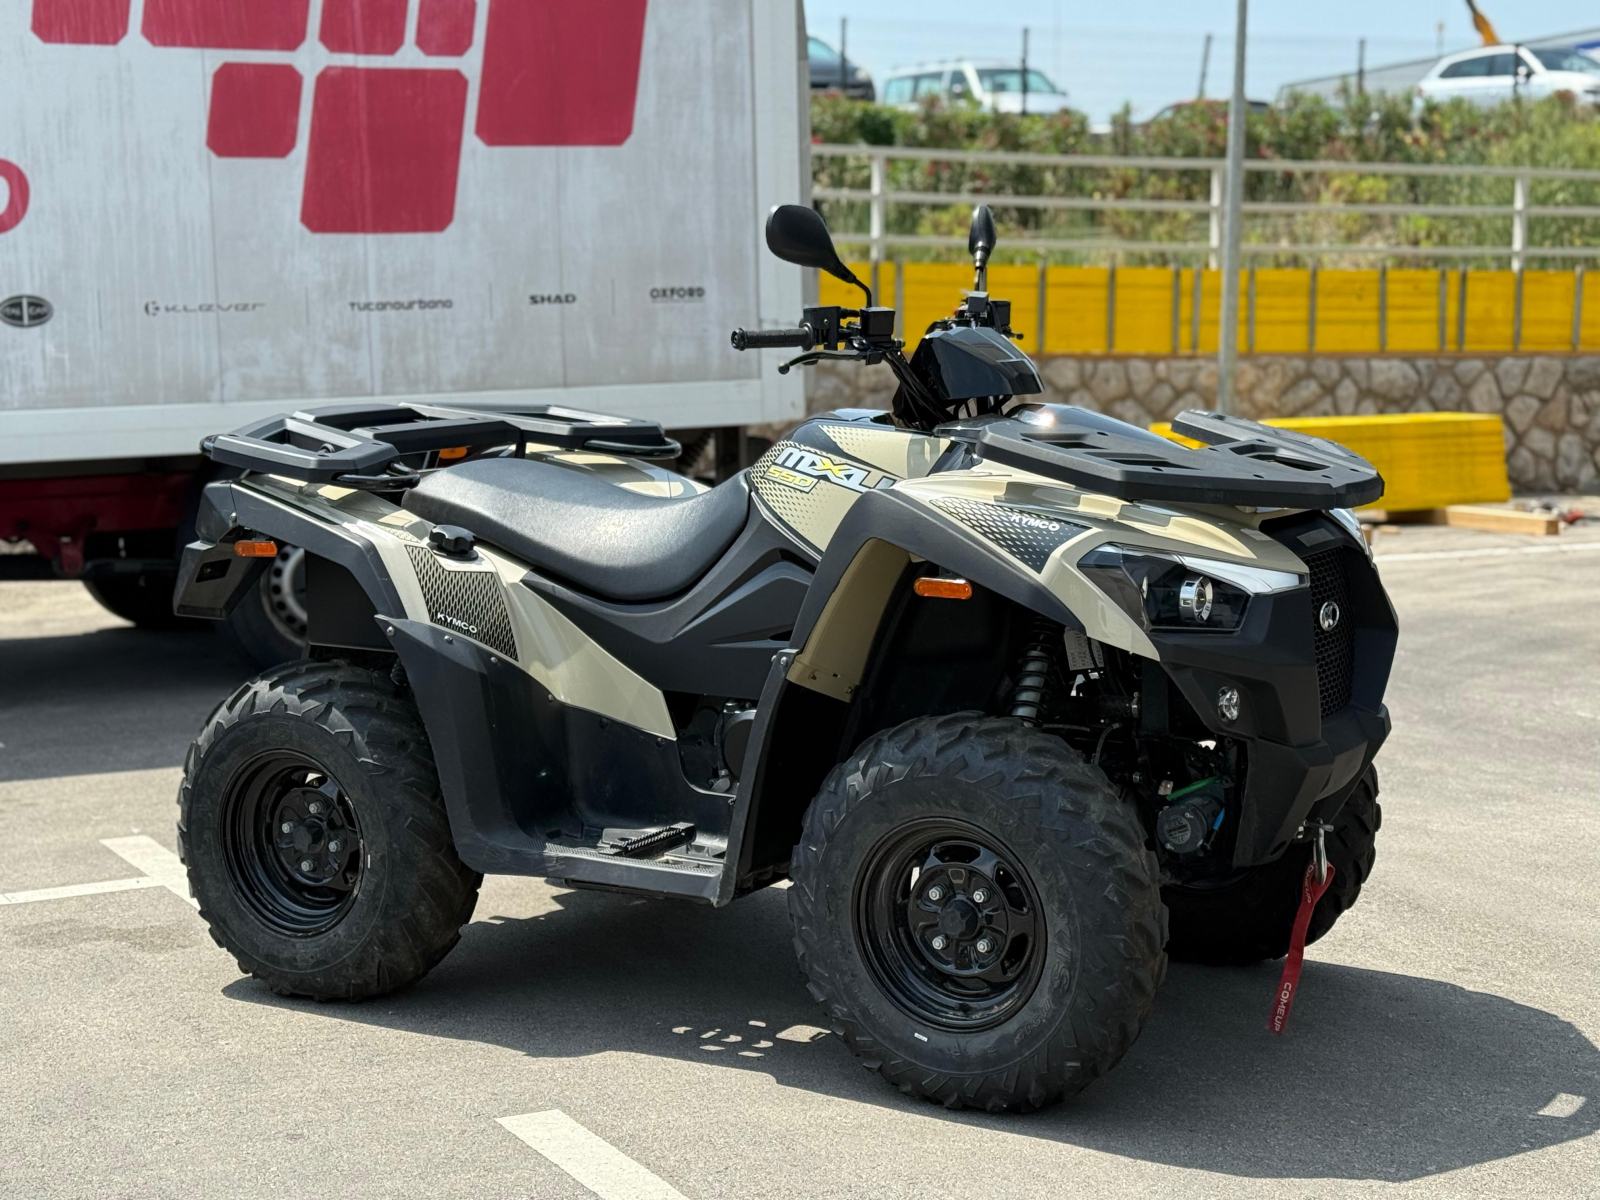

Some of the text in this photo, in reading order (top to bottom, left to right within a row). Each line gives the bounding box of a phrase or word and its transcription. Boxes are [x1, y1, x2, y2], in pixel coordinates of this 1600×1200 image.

[529, 293, 577, 306] SHAD
[650, 286, 705, 299] OXFORD
[1010, 514, 1060, 531] KYMCO
[437, 612, 478, 634] KYMCO
[1274, 982, 1292, 1032] COMEUP
